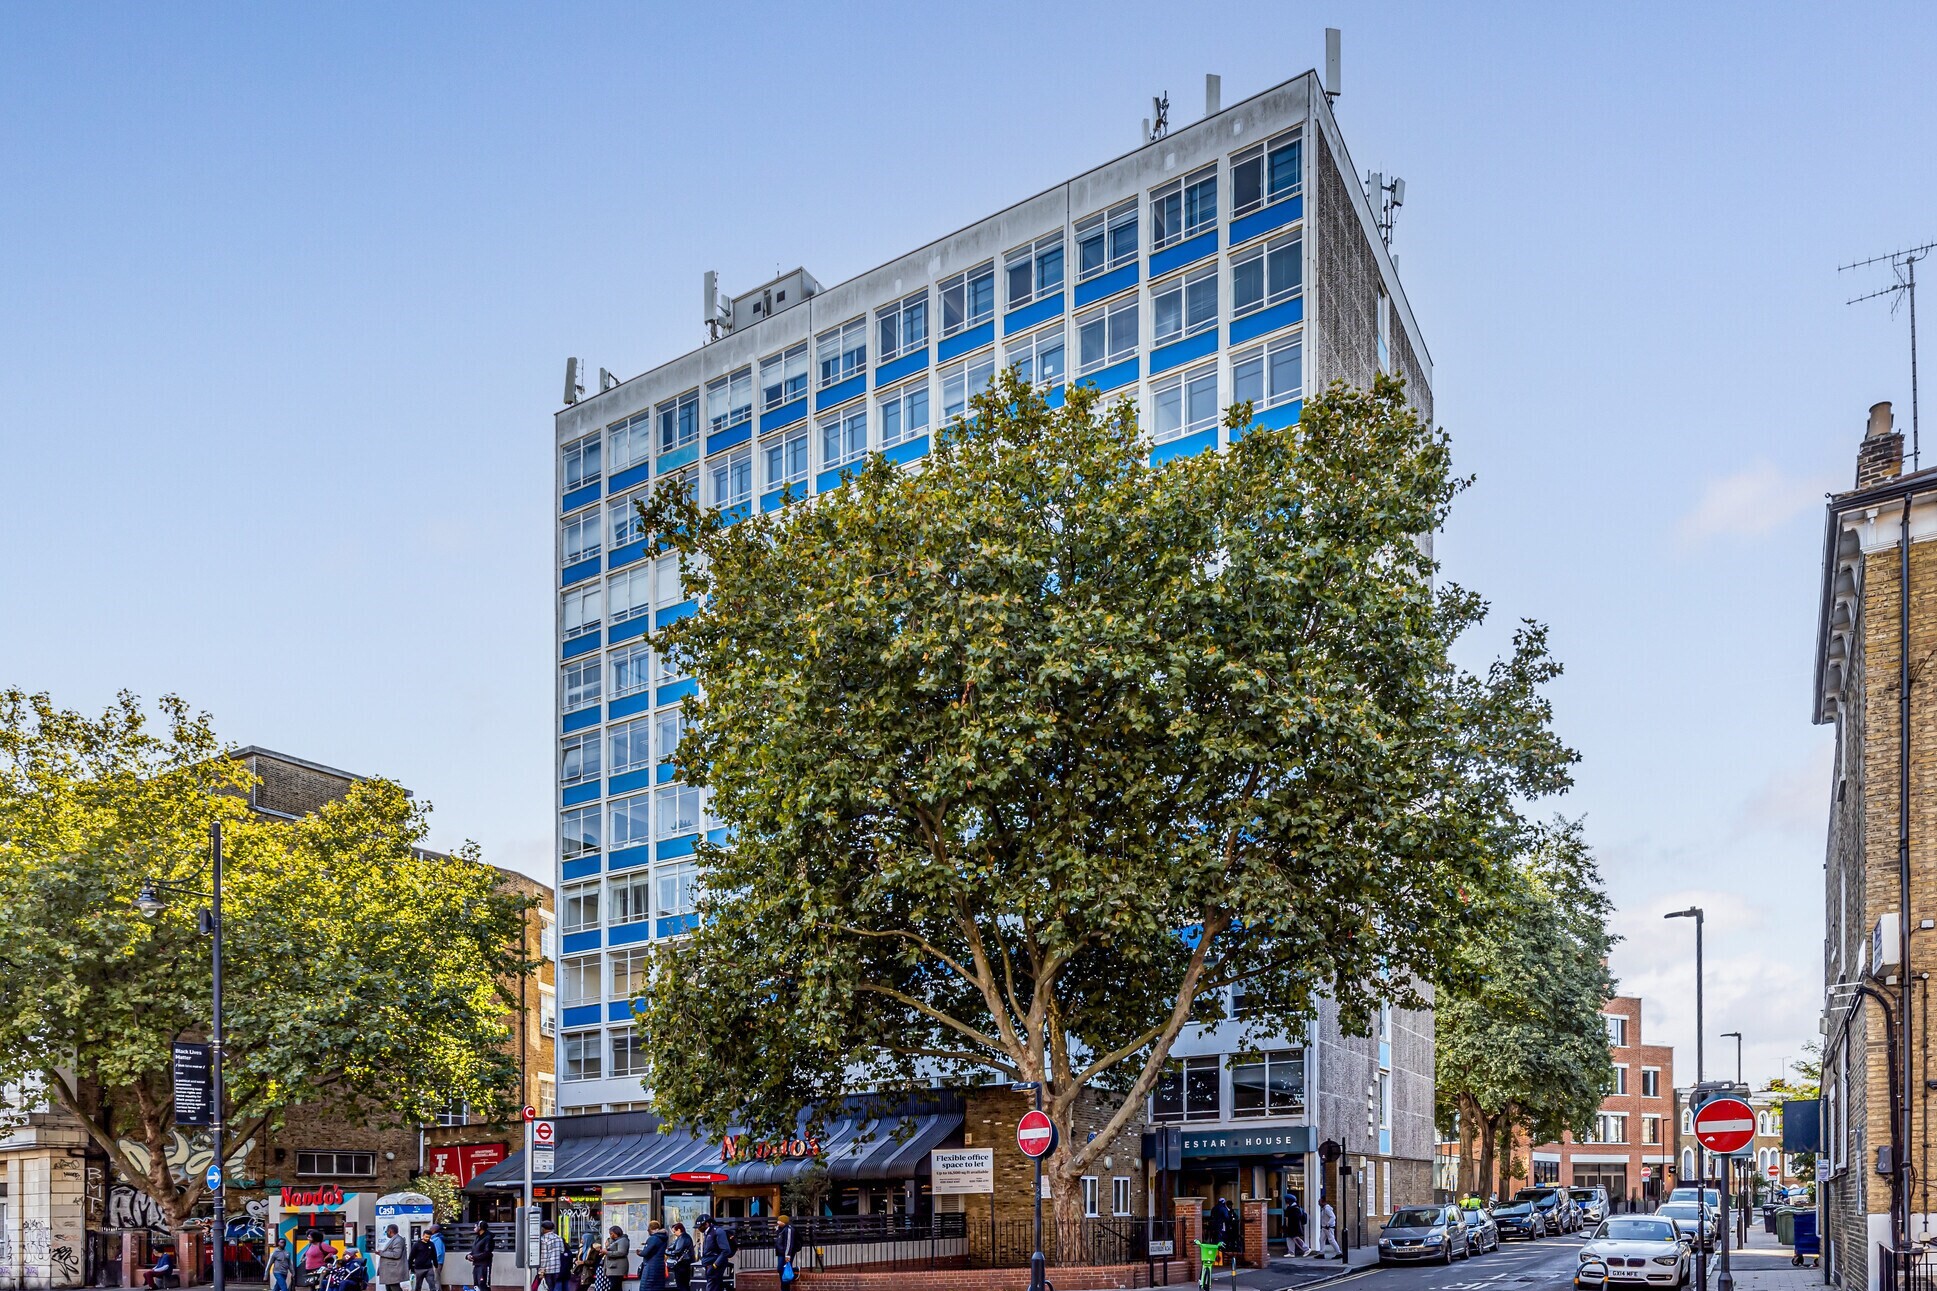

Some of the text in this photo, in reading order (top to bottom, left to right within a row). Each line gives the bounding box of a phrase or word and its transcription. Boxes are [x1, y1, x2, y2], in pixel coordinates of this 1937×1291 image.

[525, 1107, 534, 1118] C
[720, 1130, 820, 1161] Nndo's
[1184, 1139, 1226, 1149] ESTAR
[1245, 1136, 1292, 1146] HOUSE
[280, 1183, 344, 1207] Nando's
[379, 1206, 395, 1215] Cash
